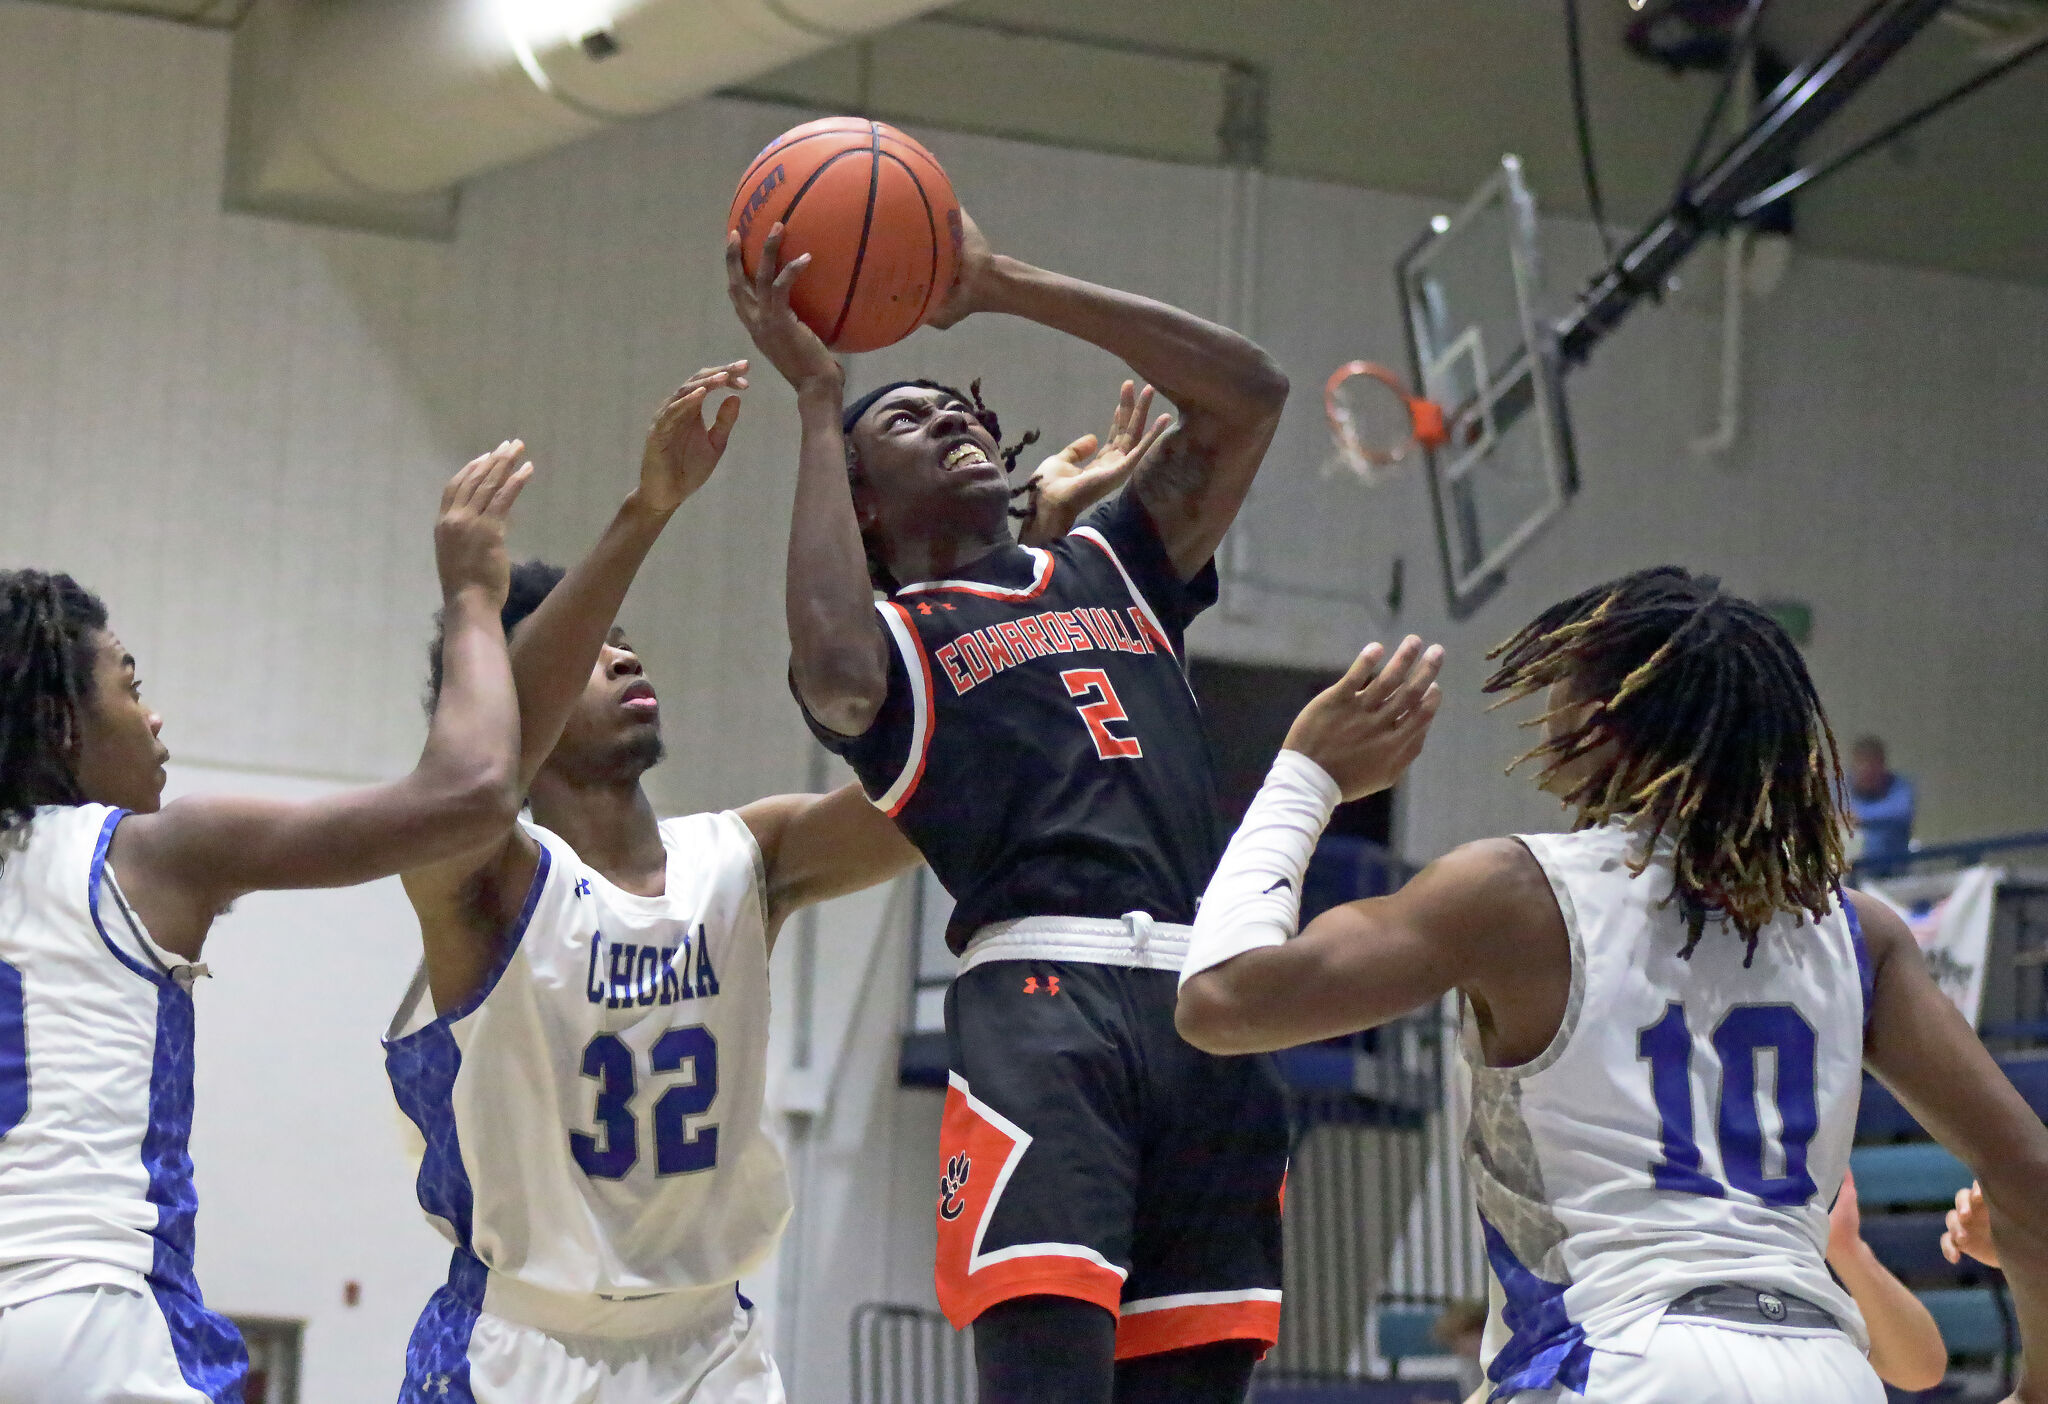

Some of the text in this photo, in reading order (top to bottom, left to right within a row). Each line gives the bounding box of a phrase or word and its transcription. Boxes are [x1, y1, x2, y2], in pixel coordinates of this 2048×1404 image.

[1060, 668, 1143, 761] 2
[568, 1022, 720, 1182] 32
[1636, 999, 1820, 1207] 10
